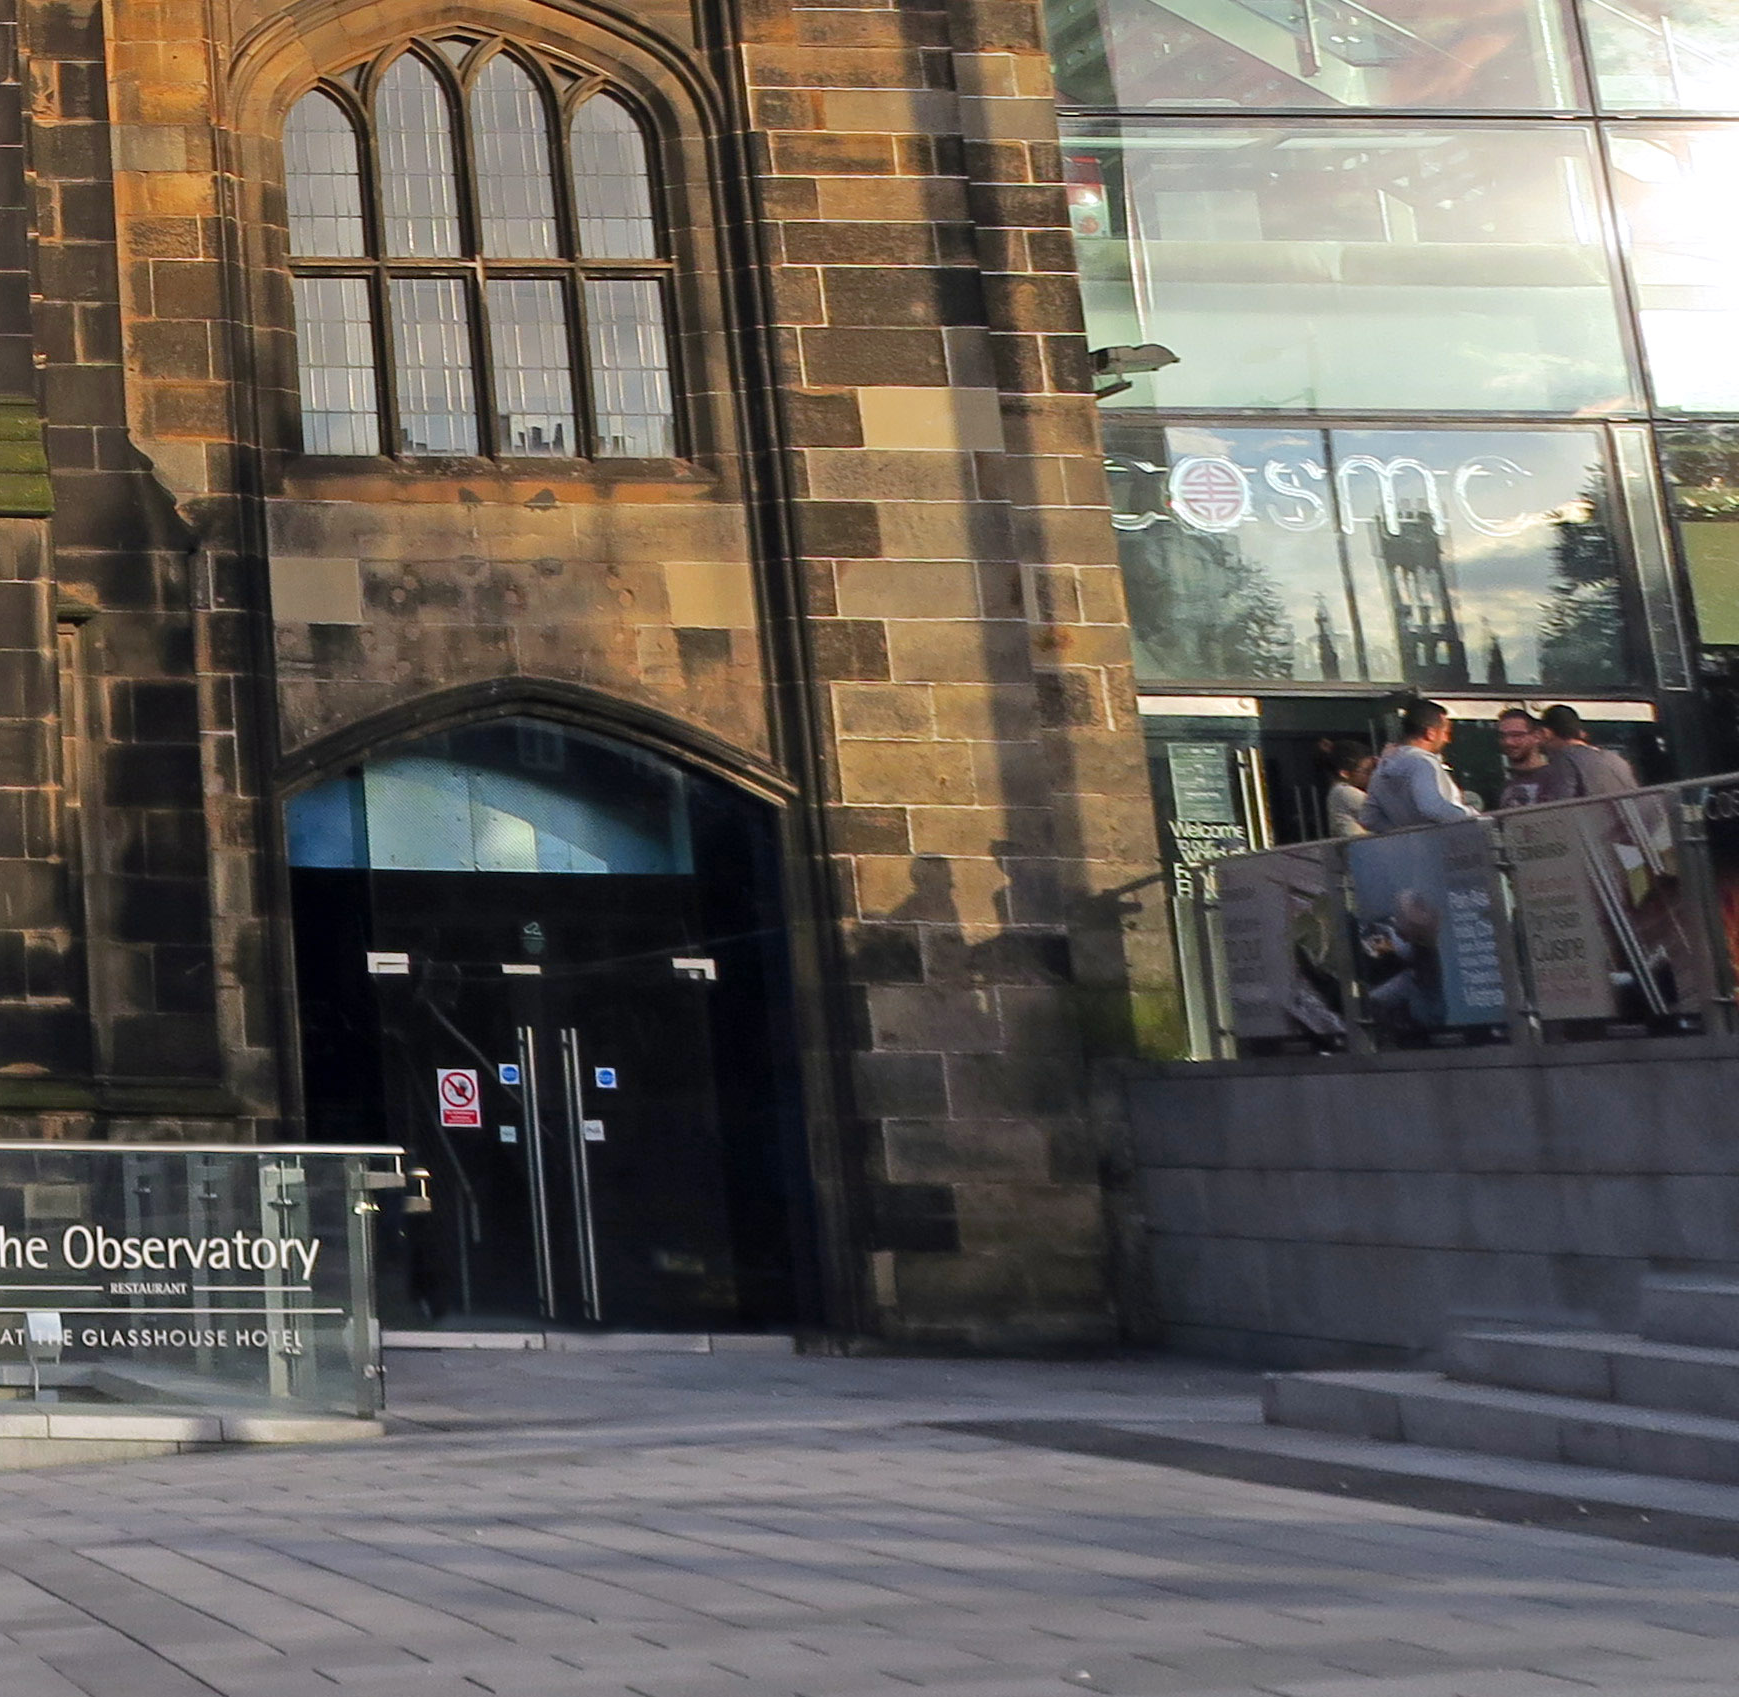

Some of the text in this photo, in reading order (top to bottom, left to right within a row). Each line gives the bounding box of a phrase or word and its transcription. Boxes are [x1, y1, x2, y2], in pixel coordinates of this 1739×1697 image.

[1167, 820, 1247, 841] Welcome
[62, 1224, 320, 1281] Observatory
[109, 1282, 188, 1296] RESTAURANT
[0, 1328, 25, 1345] AT
[81, 1328, 228, 1347] GLASSHOUSE
[235, 1329, 303, 1348] HOTEL
